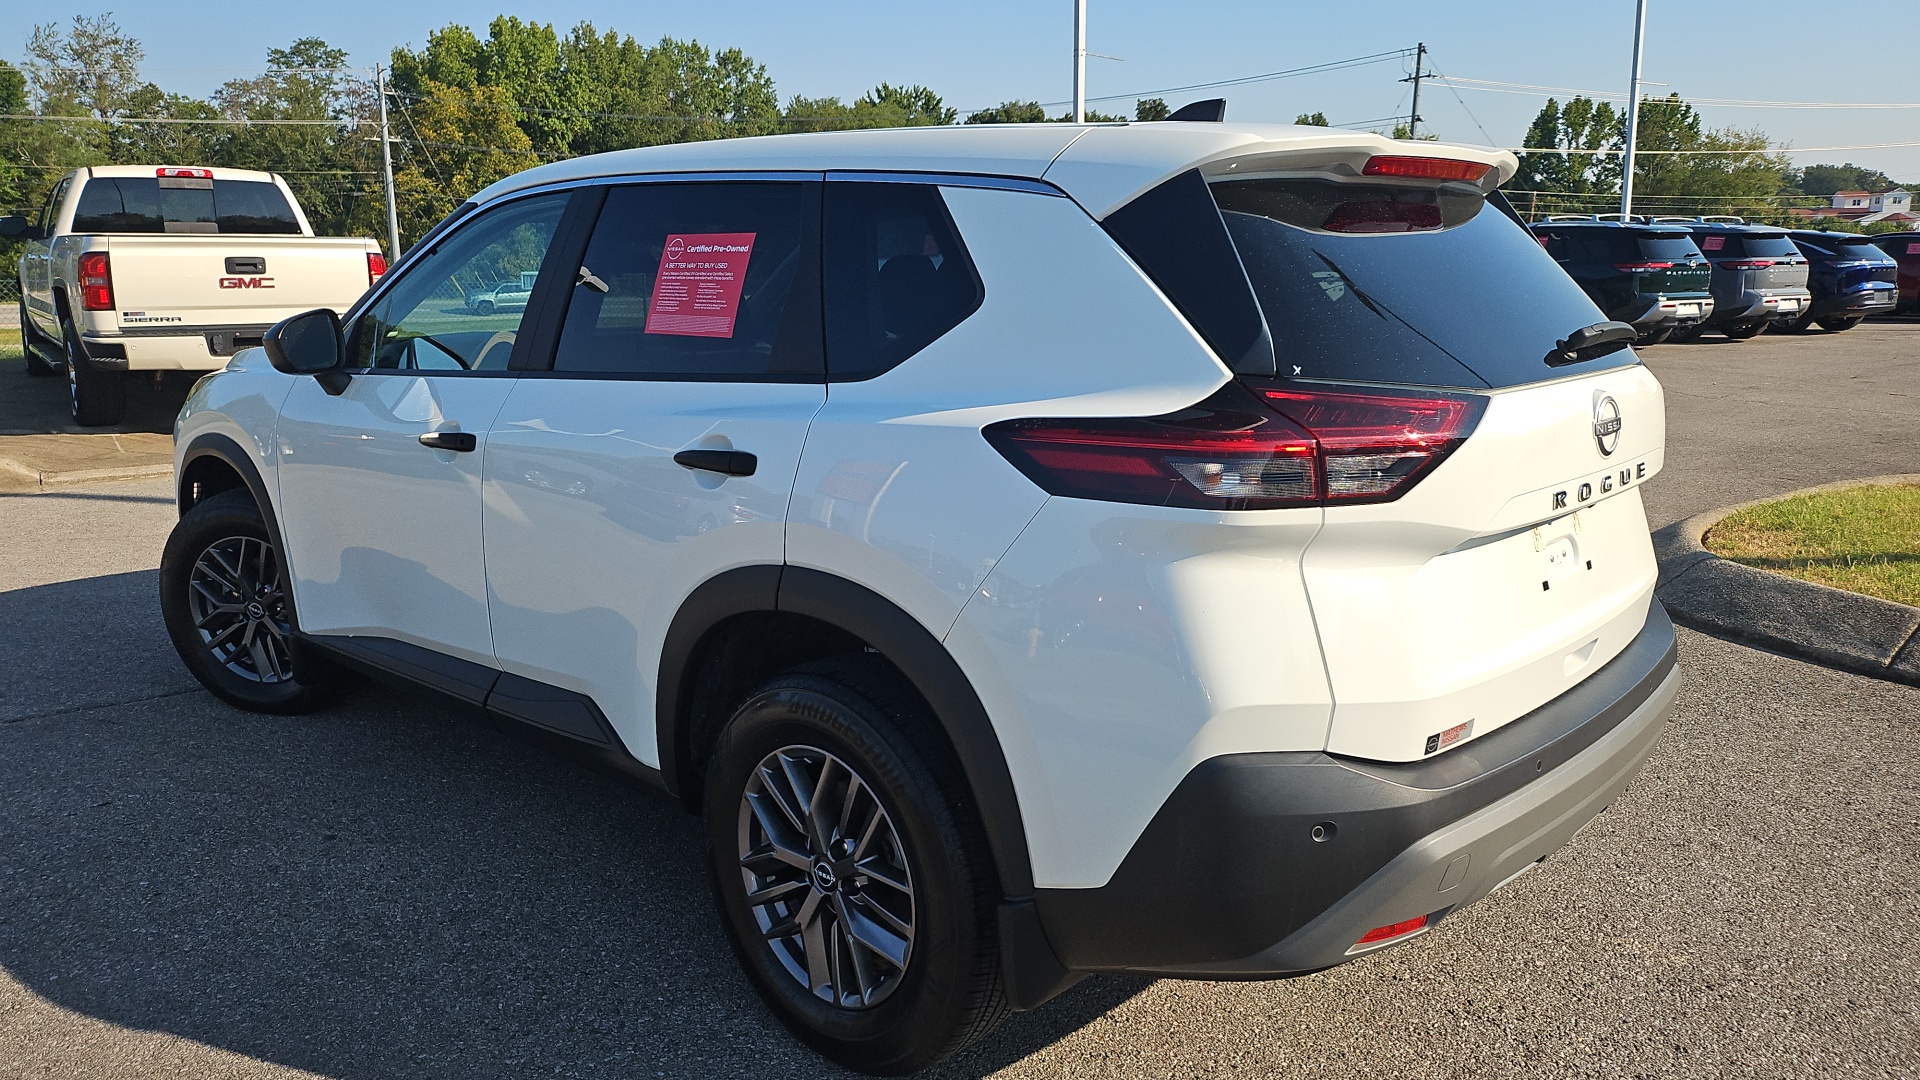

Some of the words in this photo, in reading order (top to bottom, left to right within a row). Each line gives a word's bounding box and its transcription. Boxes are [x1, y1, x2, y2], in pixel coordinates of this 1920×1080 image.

[219, 277, 275, 289] GMC
[1596, 421, 1620, 435] NISS
[1552, 462, 1646, 510] ROGUE
